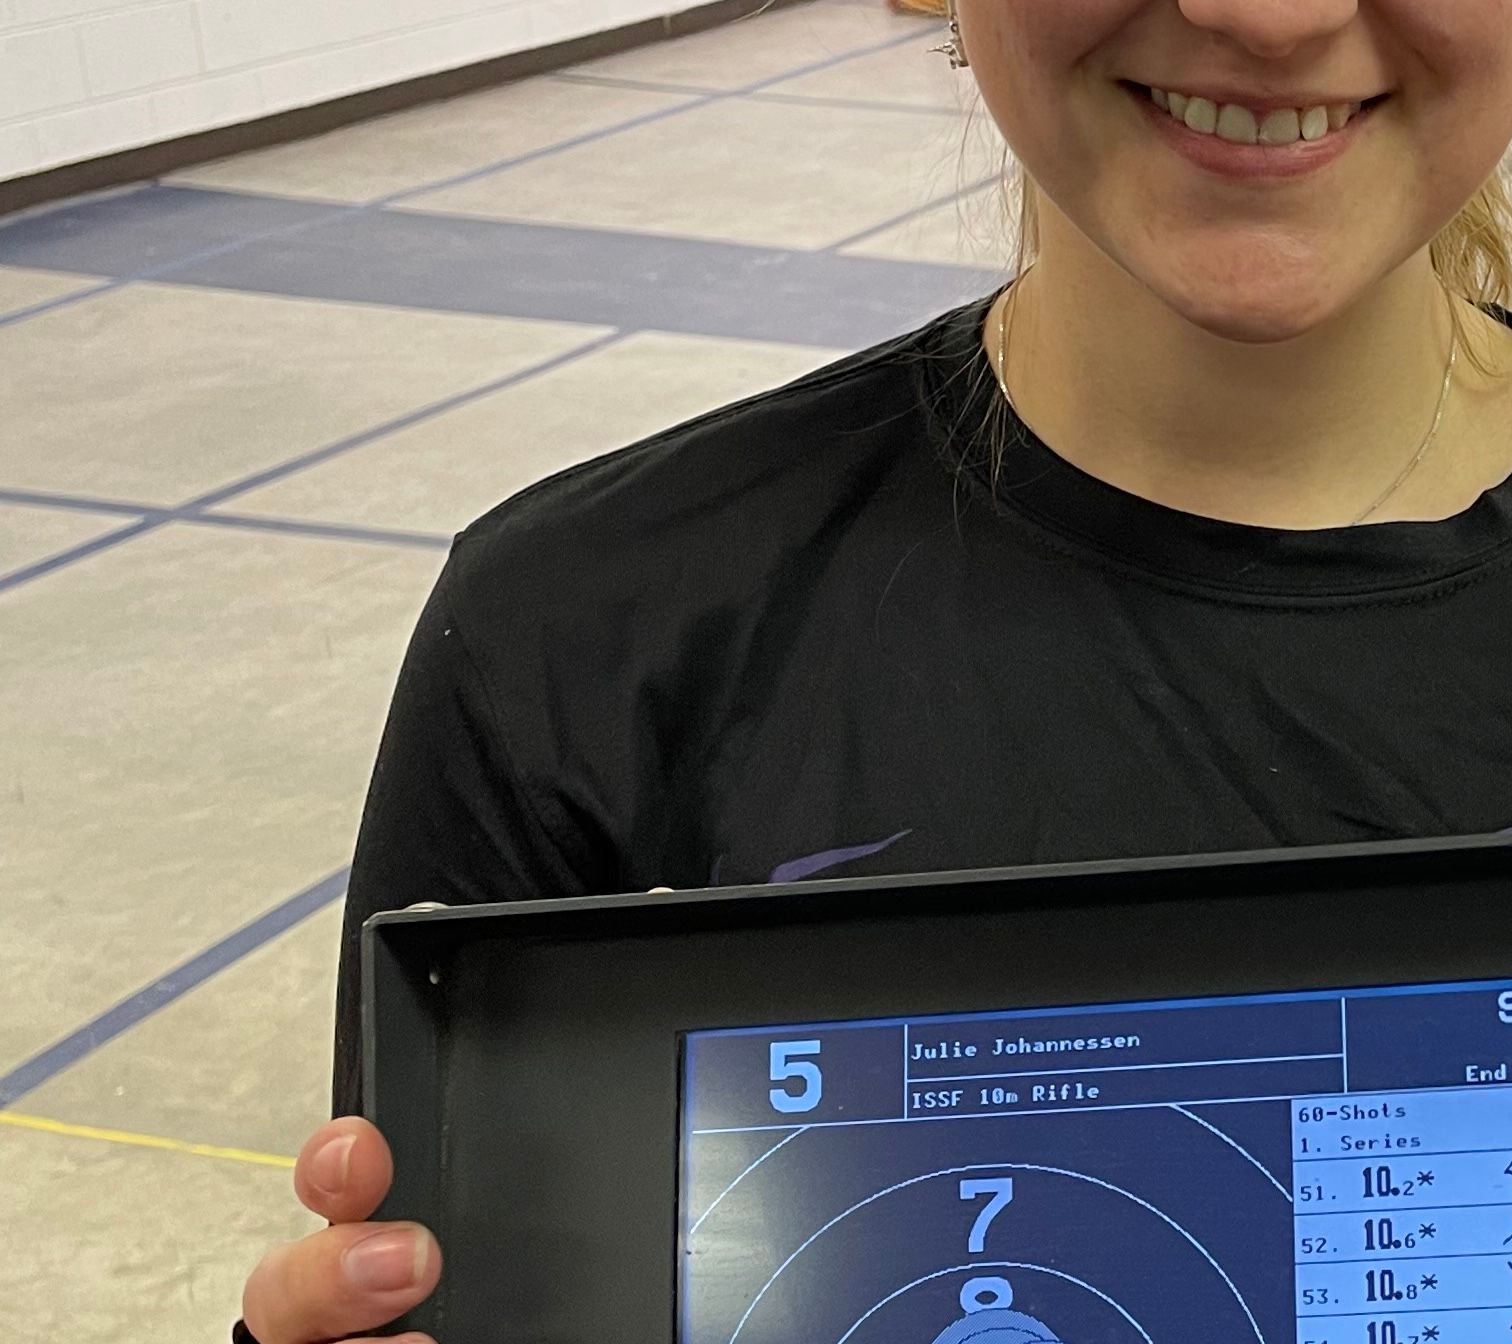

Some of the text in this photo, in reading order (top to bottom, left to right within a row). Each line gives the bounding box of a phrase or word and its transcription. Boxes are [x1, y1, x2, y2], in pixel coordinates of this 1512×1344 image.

[910, 1035, 1140, 1060] Julie Johannessen
[769, 1039, 822, 1114] 5
[1465, 1063, 1508, 1084] End
[912, 1082, 1100, 1109] ISSF 10m Rifle
[1298, 1102, 1406, 1123] 60-Shots
[1301, 1133, 1421, 1154] 1. Series
[1300, 1185, 1337, 1202] 51.
[959, 1177, 1013, 1253] 7
[1301, 1237, 1338, 1254] 52.
[1302, 1288, 1339, 1306] 53.
